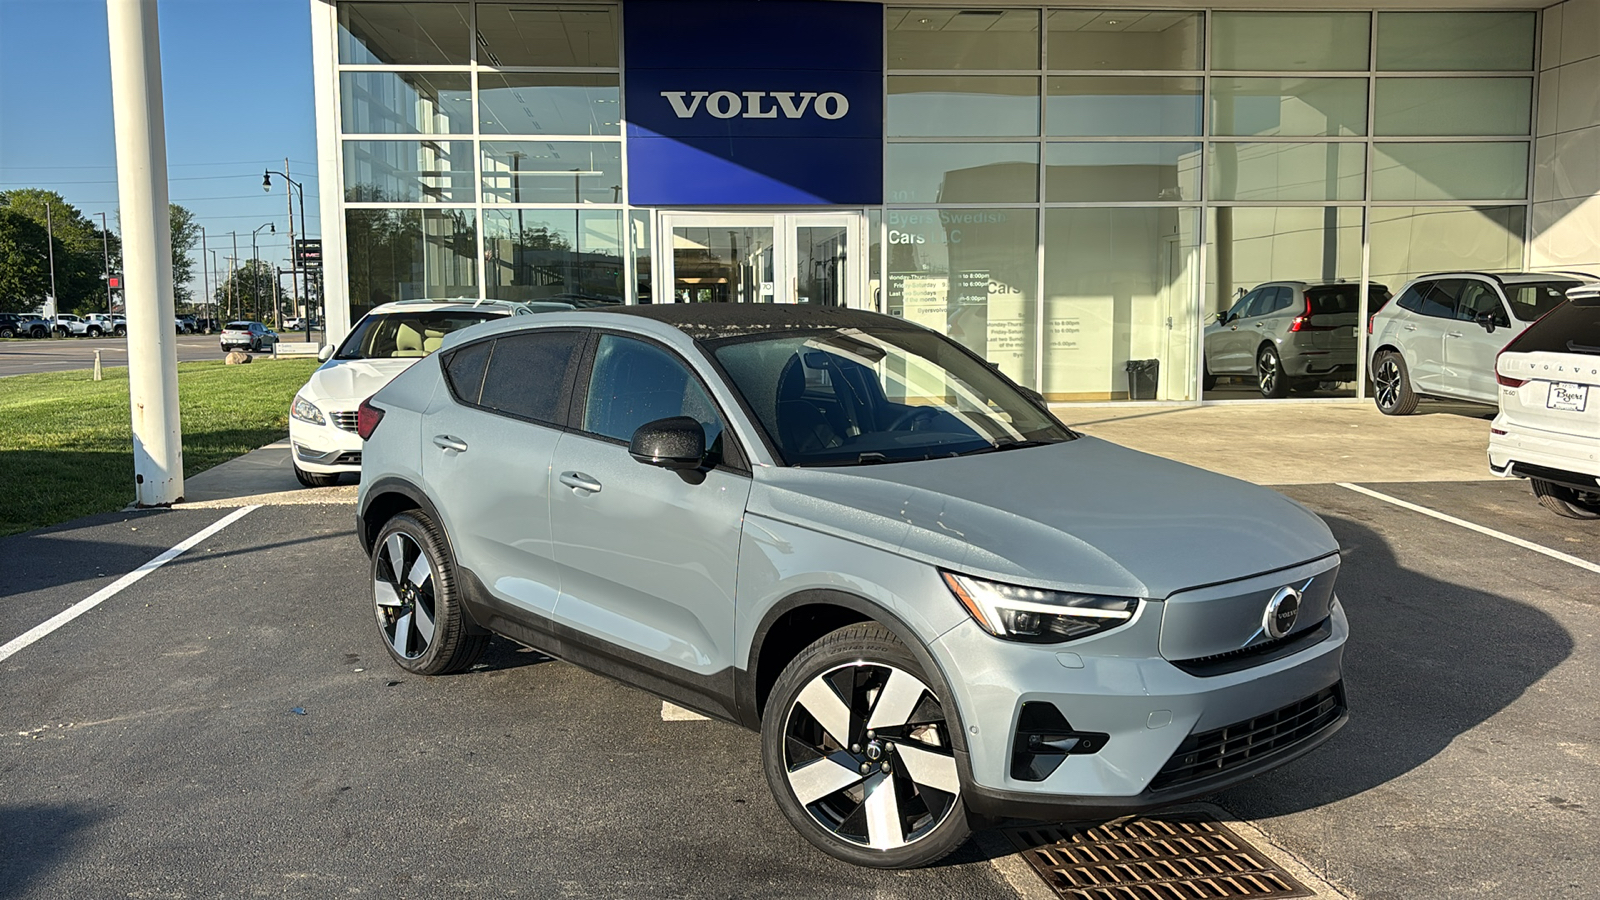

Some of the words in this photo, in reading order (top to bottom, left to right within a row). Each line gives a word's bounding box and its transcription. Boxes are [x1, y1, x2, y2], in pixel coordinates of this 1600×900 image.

[660, 90, 850, 120] VOLVO
[889, 212, 934, 228] Byers
[940, 211, 1006, 224] Swedish
[889, 230, 926, 244] Cars
[1530, 363, 1598, 375] VOLVO
[1553, 387, 1583, 403] Byers
[1278, 608, 1298, 619] VOLVO
